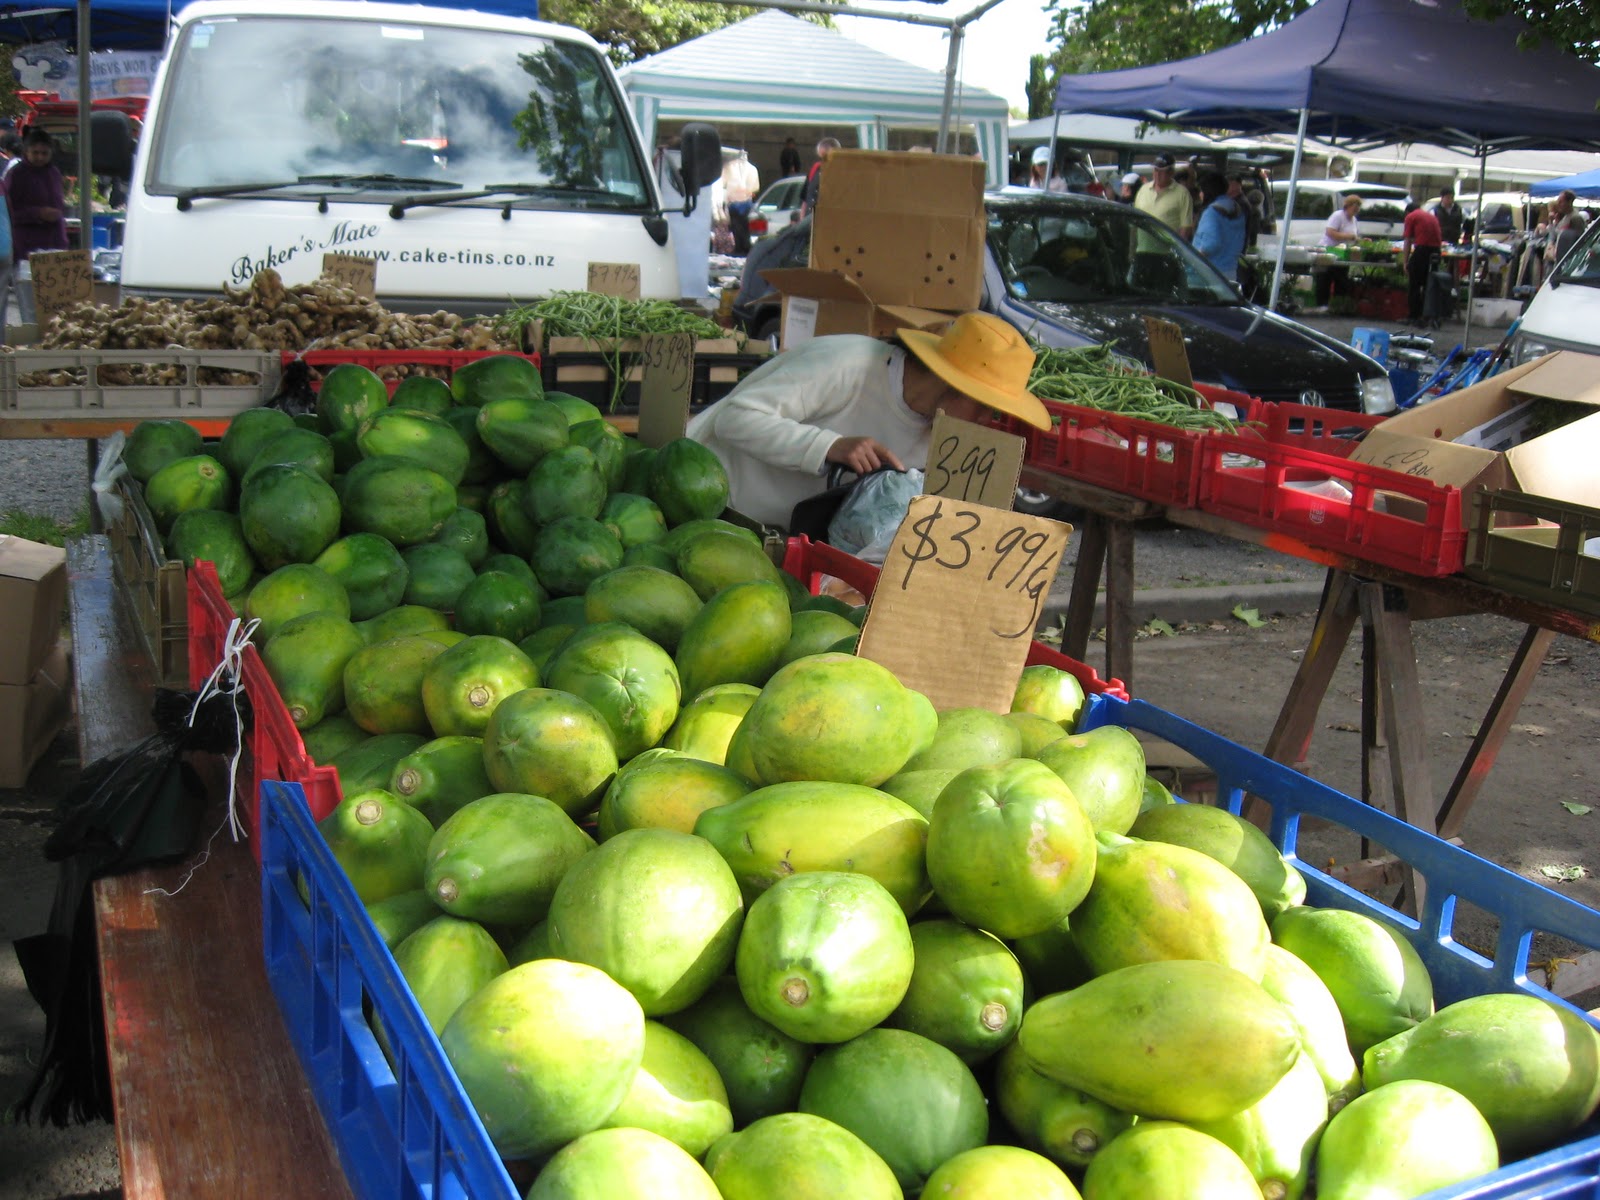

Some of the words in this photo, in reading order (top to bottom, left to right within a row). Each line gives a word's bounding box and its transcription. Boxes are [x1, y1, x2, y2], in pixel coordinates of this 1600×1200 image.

[231, 235, 316, 285] Baker's
[319, 220, 381, 249] Mate
[930, 436, 997, 501] 3.99
